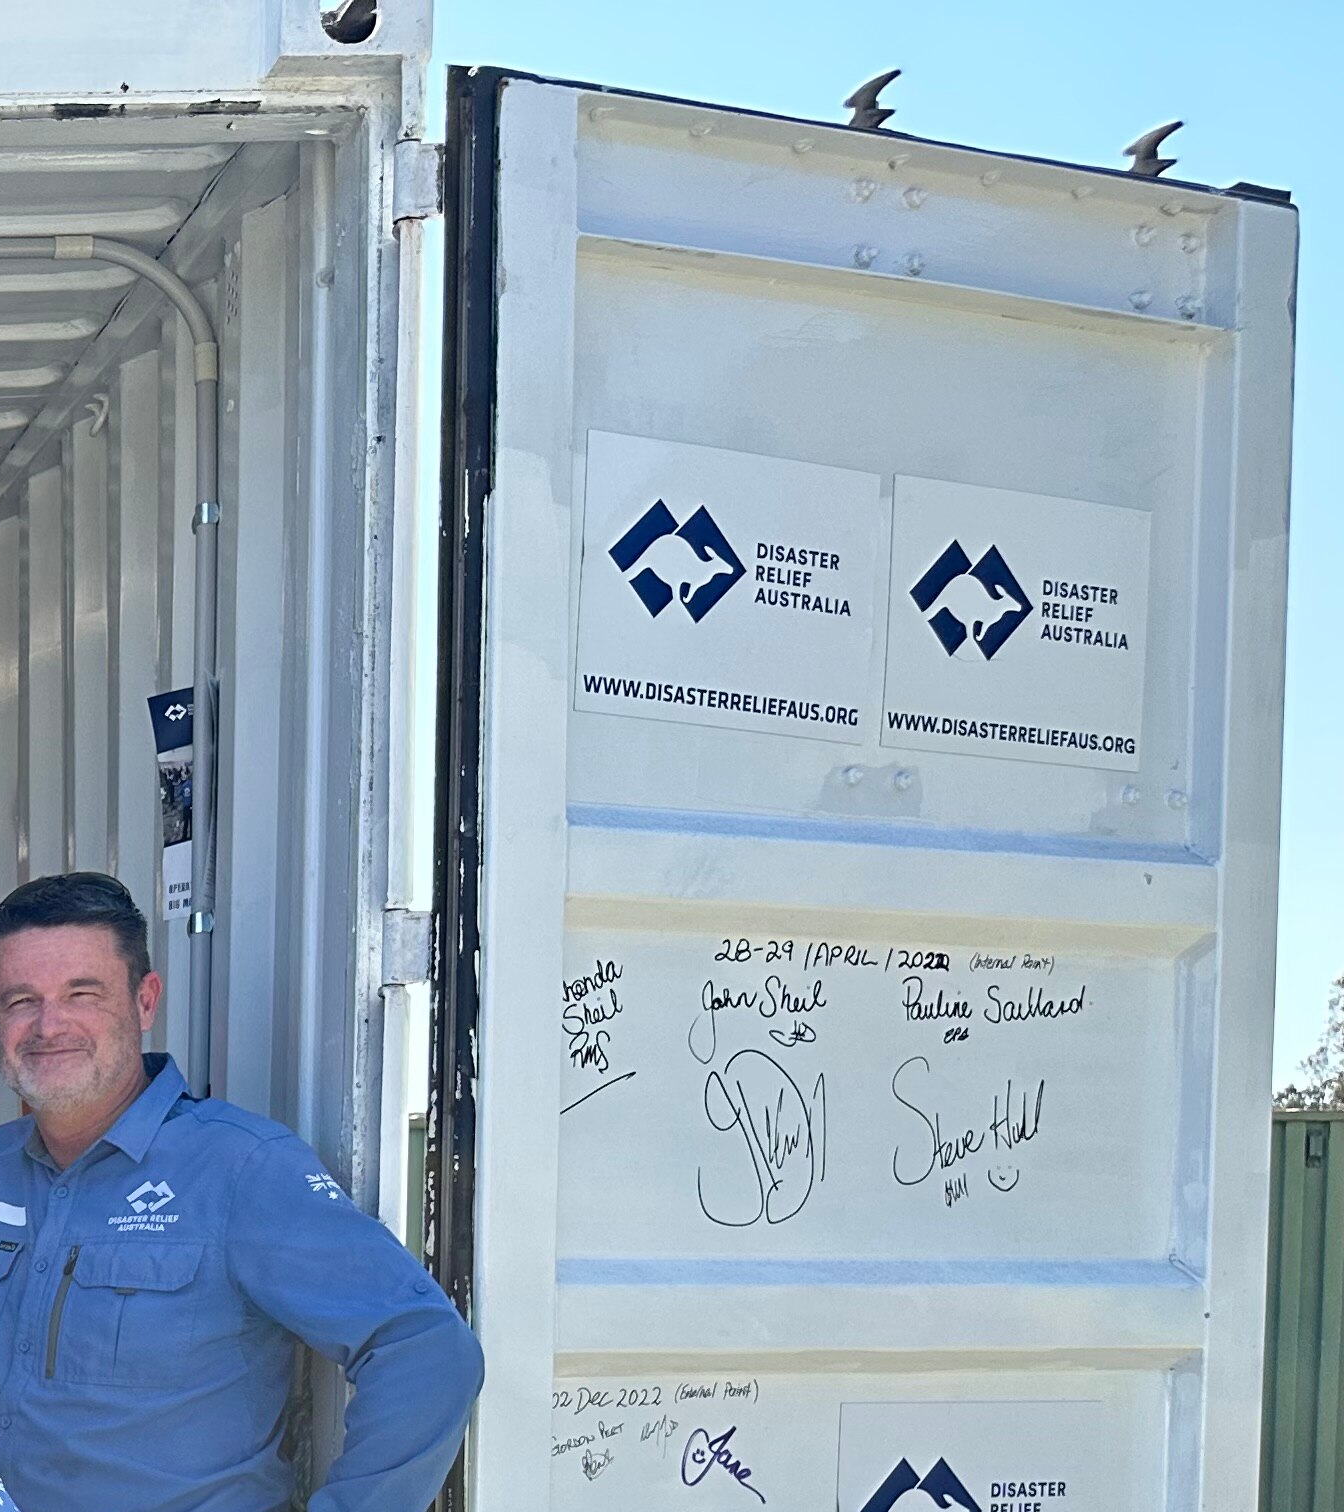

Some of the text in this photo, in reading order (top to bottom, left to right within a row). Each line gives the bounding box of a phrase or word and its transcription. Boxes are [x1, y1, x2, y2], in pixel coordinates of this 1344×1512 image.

[756, 542, 841, 572] DISASTER
[755, 564, 813, 588] RELIEF
[754, 587, 852, 617] AUSTRALIA
[1042, 579, 1119, 606] DISASTER
[1041, 602, 1094, 624] RELIEF
[1040, 623, 1129, 651] AUSTRALIA
[583, 674, 859, 727] WWW.DISASTERRELIEFAUS.ORG
[887, 711, 1136, 756] WWW.DISASTERRELIEFAUS.ORG
[561, 959, 623, 1002] honda
[902, 976, 973, 1021] Pauline
[892, 1055, 985, 1186] Steve
[108, 1214, 179, 1225] DISASTER RELIEF
[117, 1223, 165, 1232] AUSTRALIA
[574, 1387, 613, 1415] Dec
[616, 1387, 662, 1407] 2022
[991, 1481, 1067, 1499] DISASTER
